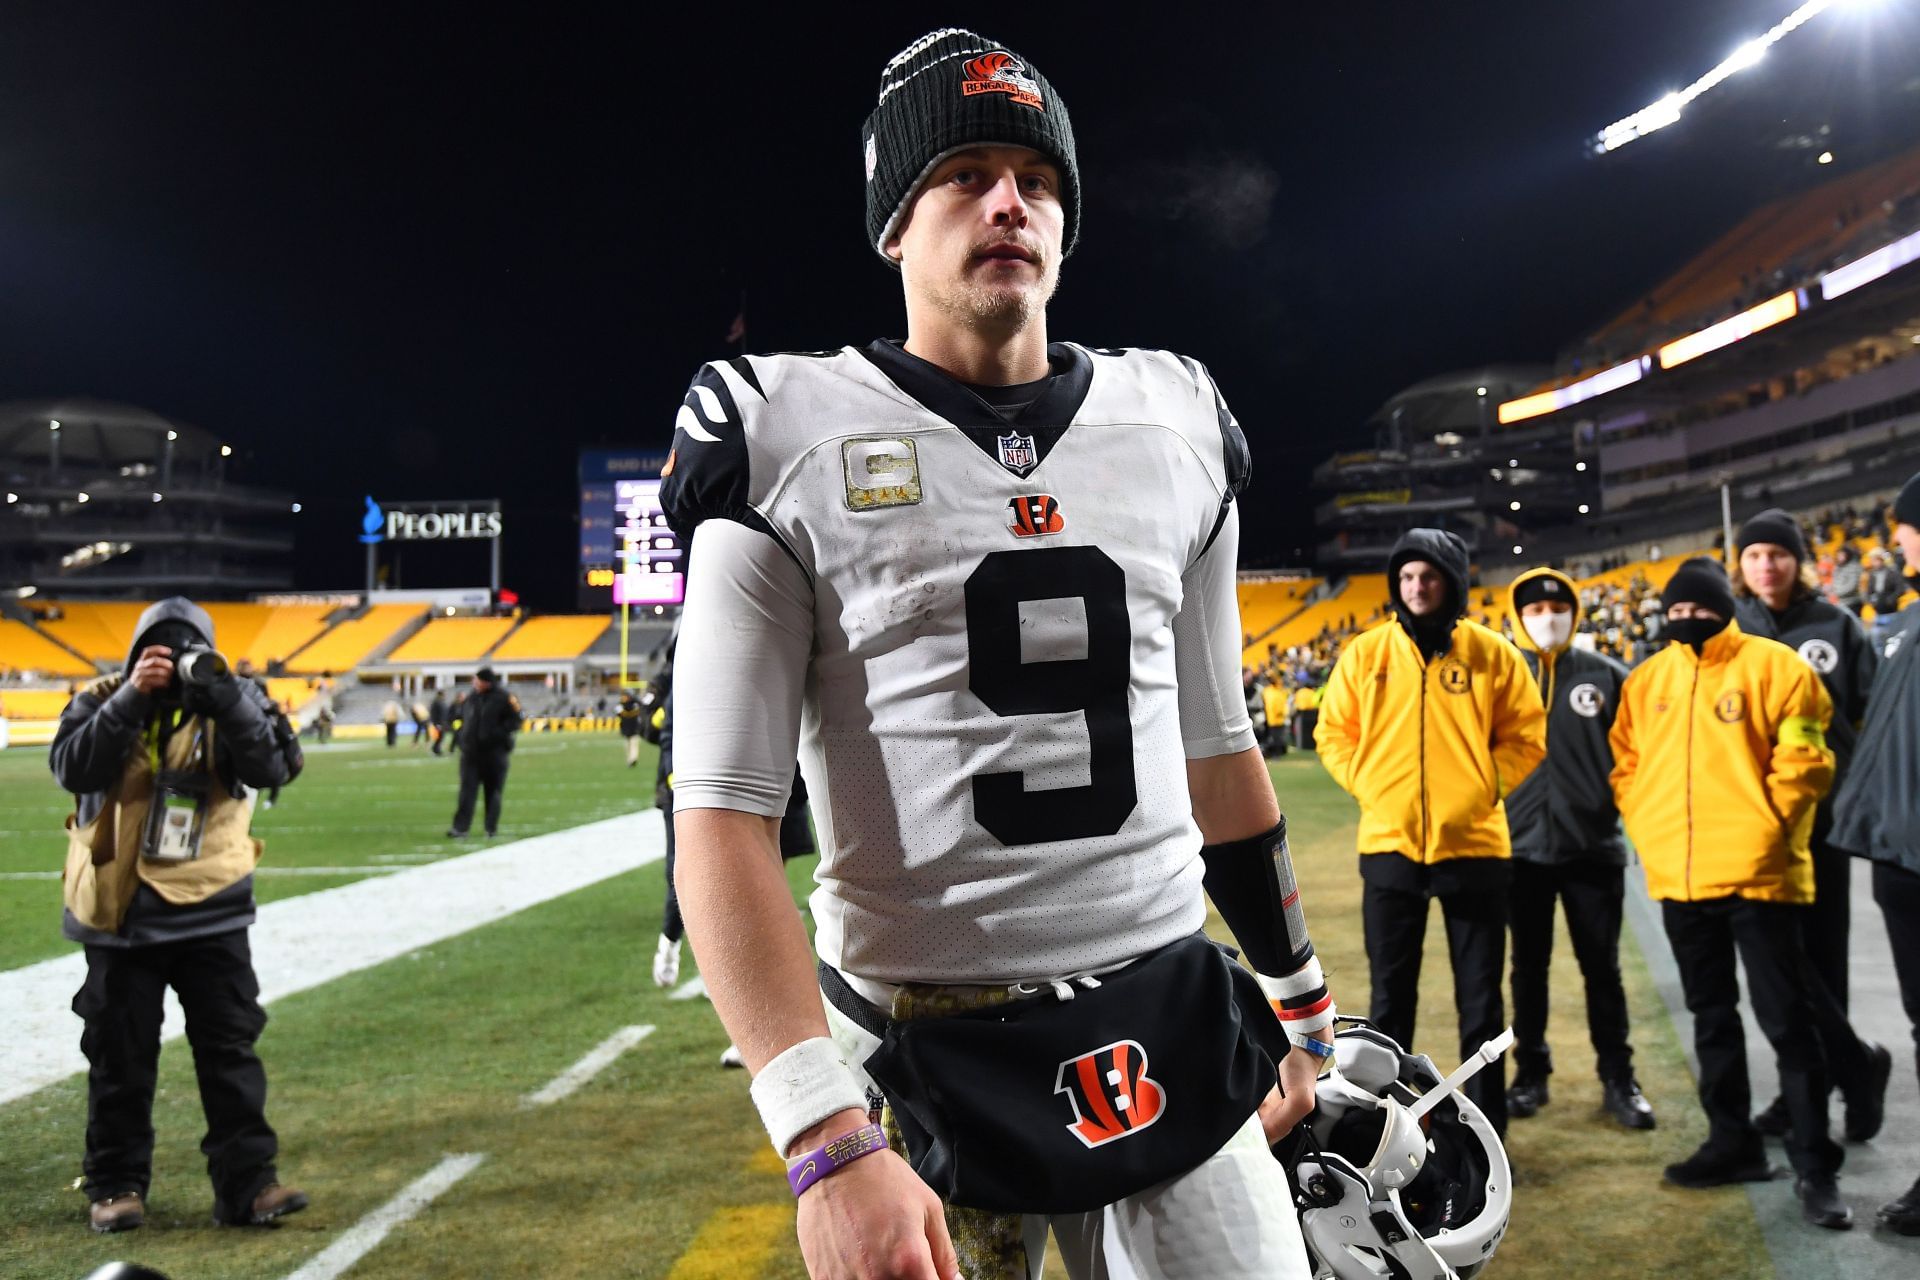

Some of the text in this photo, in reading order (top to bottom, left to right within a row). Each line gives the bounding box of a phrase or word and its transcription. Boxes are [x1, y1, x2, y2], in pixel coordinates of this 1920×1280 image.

[1004, 449, 1031, 467] NFL
[387, 511, 502, 539] PEOPLES
[964, 545, 1138, 846] 9
